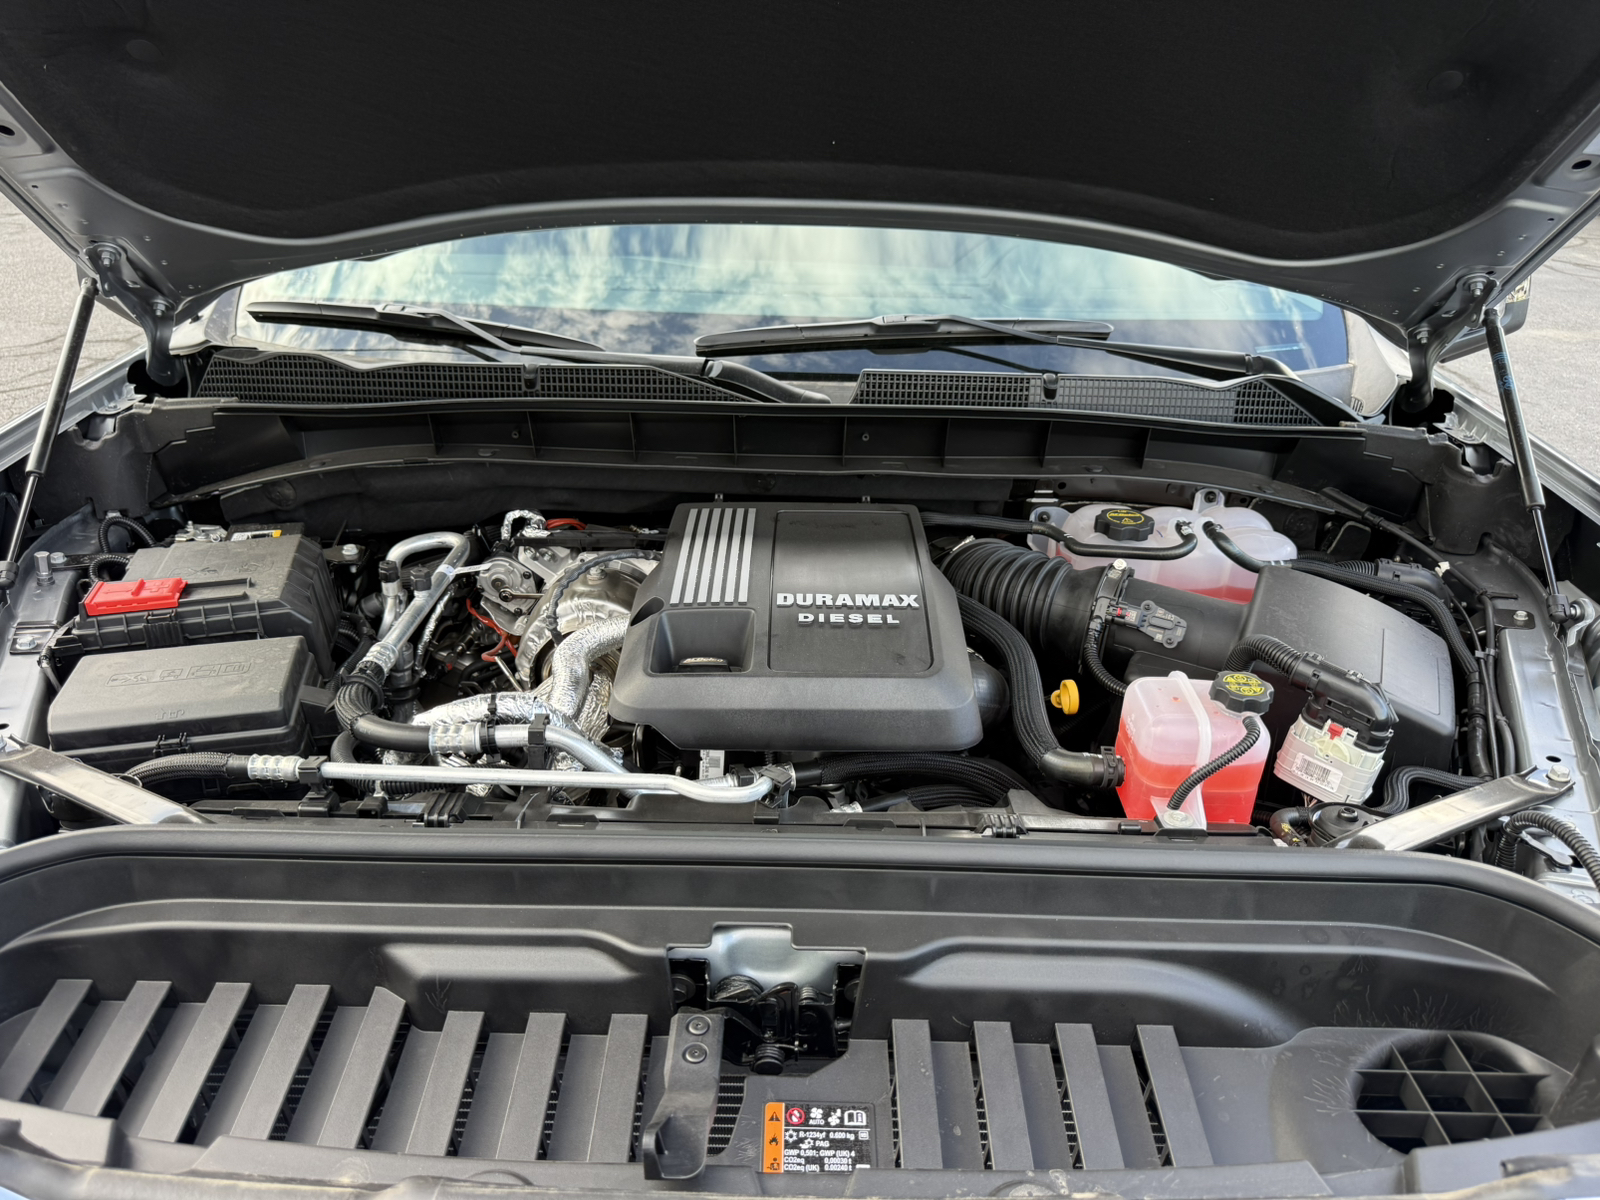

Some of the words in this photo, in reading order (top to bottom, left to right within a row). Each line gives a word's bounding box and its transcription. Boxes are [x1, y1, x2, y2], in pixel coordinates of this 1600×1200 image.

[776, 592, 920, 609] DURAMAX
[798, 613, 900, 625] DIESEL
[799, 1131, 826, 1140] R-1234yf
[846, 1132, 855, 1140] kg
[836, 1150, 850, 1158] (UK)
[784, 1156, 805, 1164] CO2eq
[784, 1164, 805, 1172] CO2eq
[805, 1164, 820, 1172] (UK)
